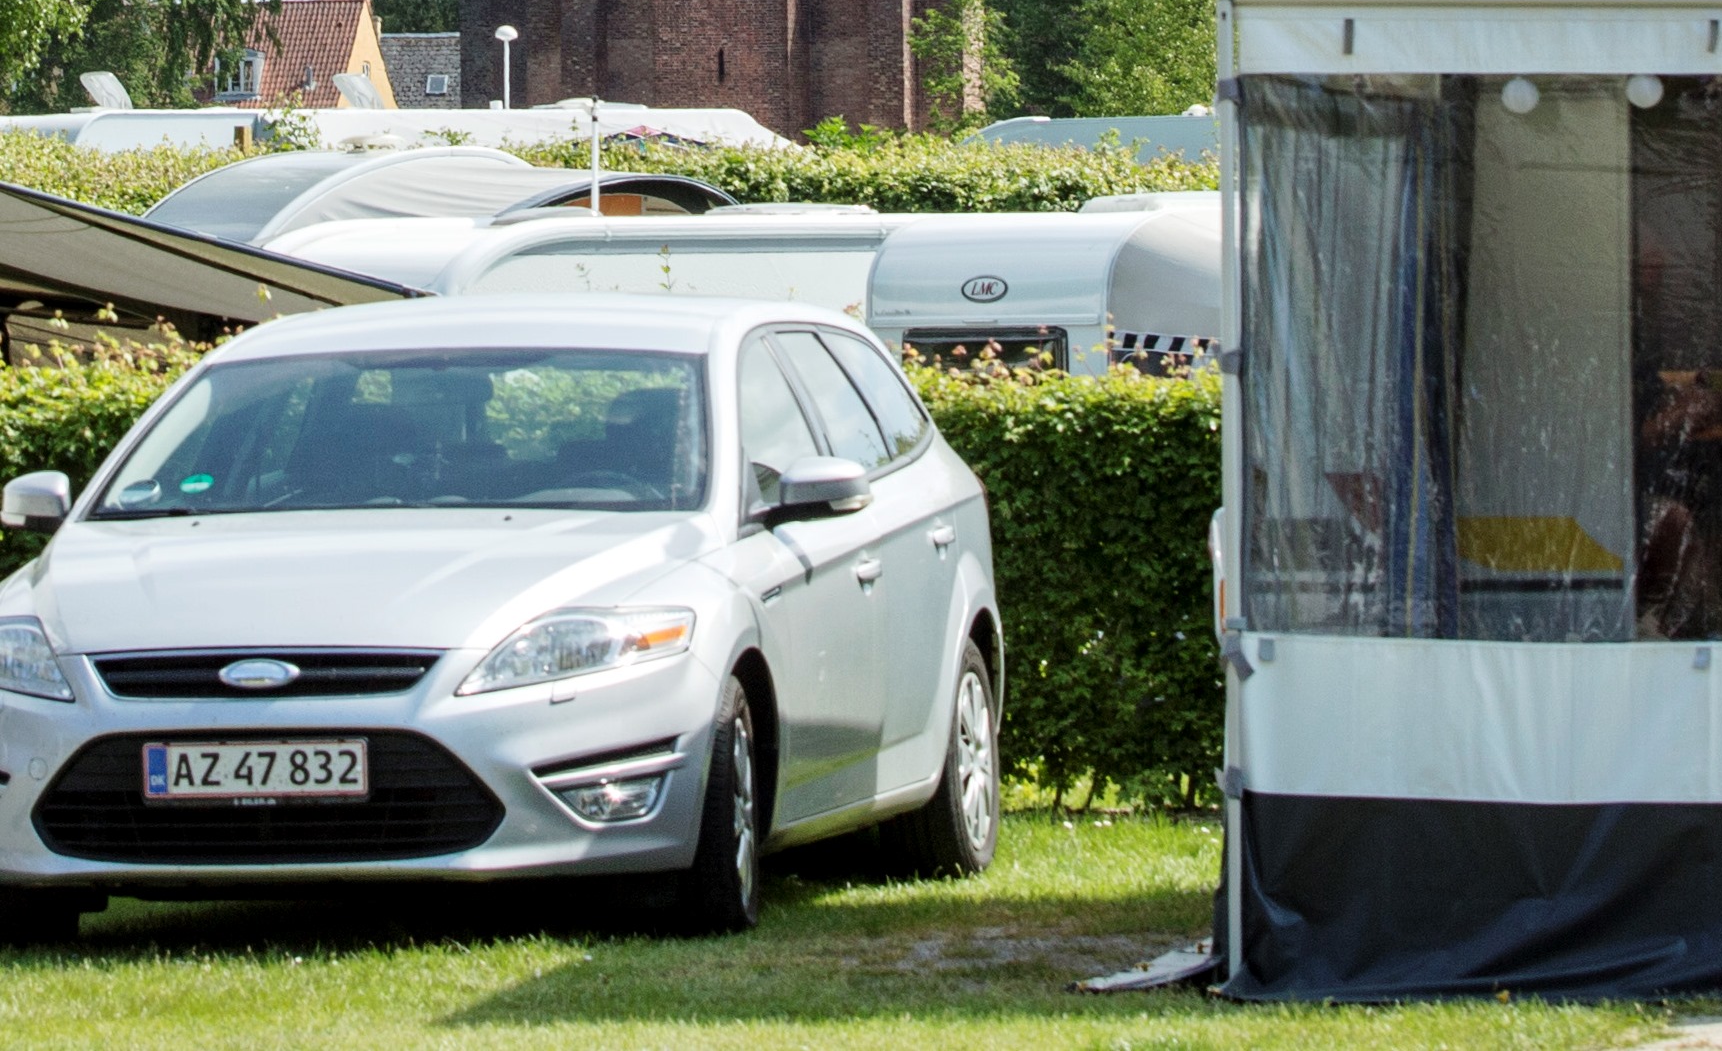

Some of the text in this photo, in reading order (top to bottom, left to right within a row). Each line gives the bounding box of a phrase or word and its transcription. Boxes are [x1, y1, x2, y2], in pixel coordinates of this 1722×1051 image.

[970, 281, 998, 296] LMC
[173, 750, 358, 786] AZ 47 832
[150, 774, 165, 786] DK
